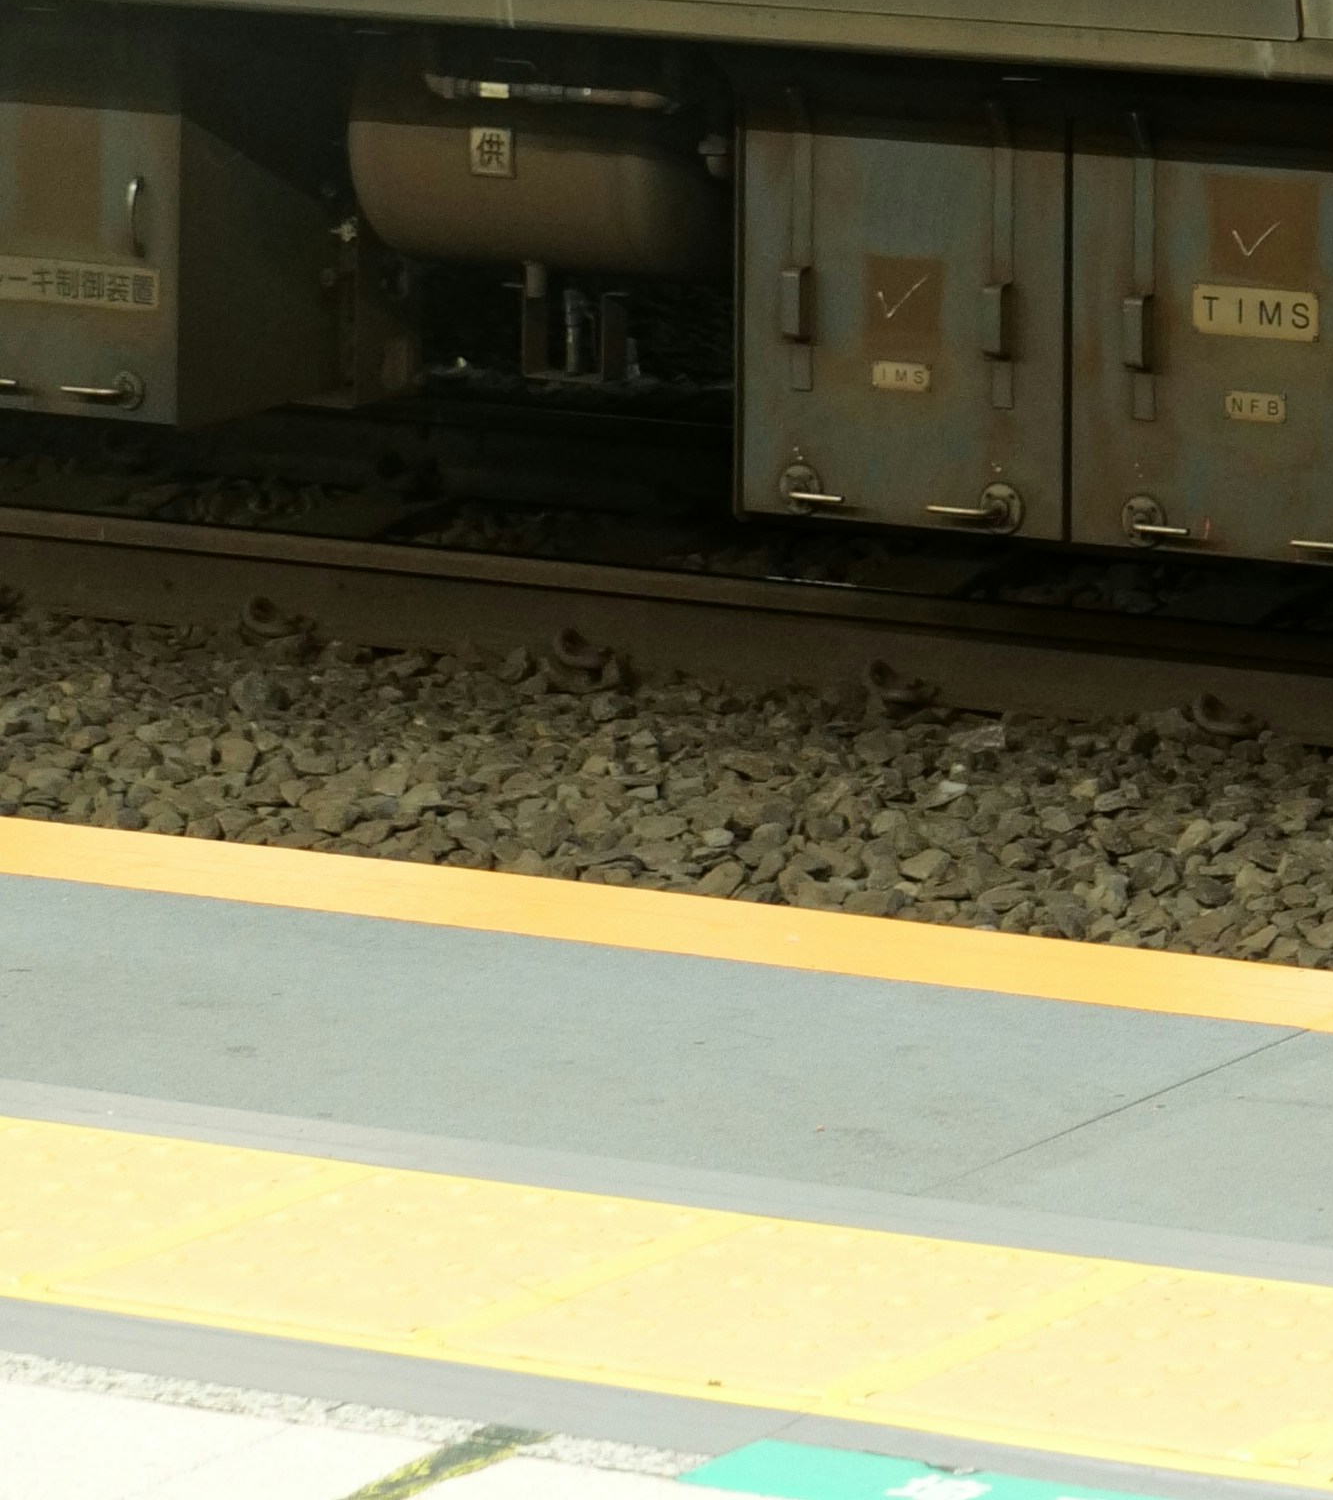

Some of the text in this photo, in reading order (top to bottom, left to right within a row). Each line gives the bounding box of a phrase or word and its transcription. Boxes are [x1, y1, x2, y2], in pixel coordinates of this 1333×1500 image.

[0, 267, 155, 305] ーキ制御装置
[1201, 294, 1310, 330] TIMS
[1230, 397, 1280, 416] NFB
